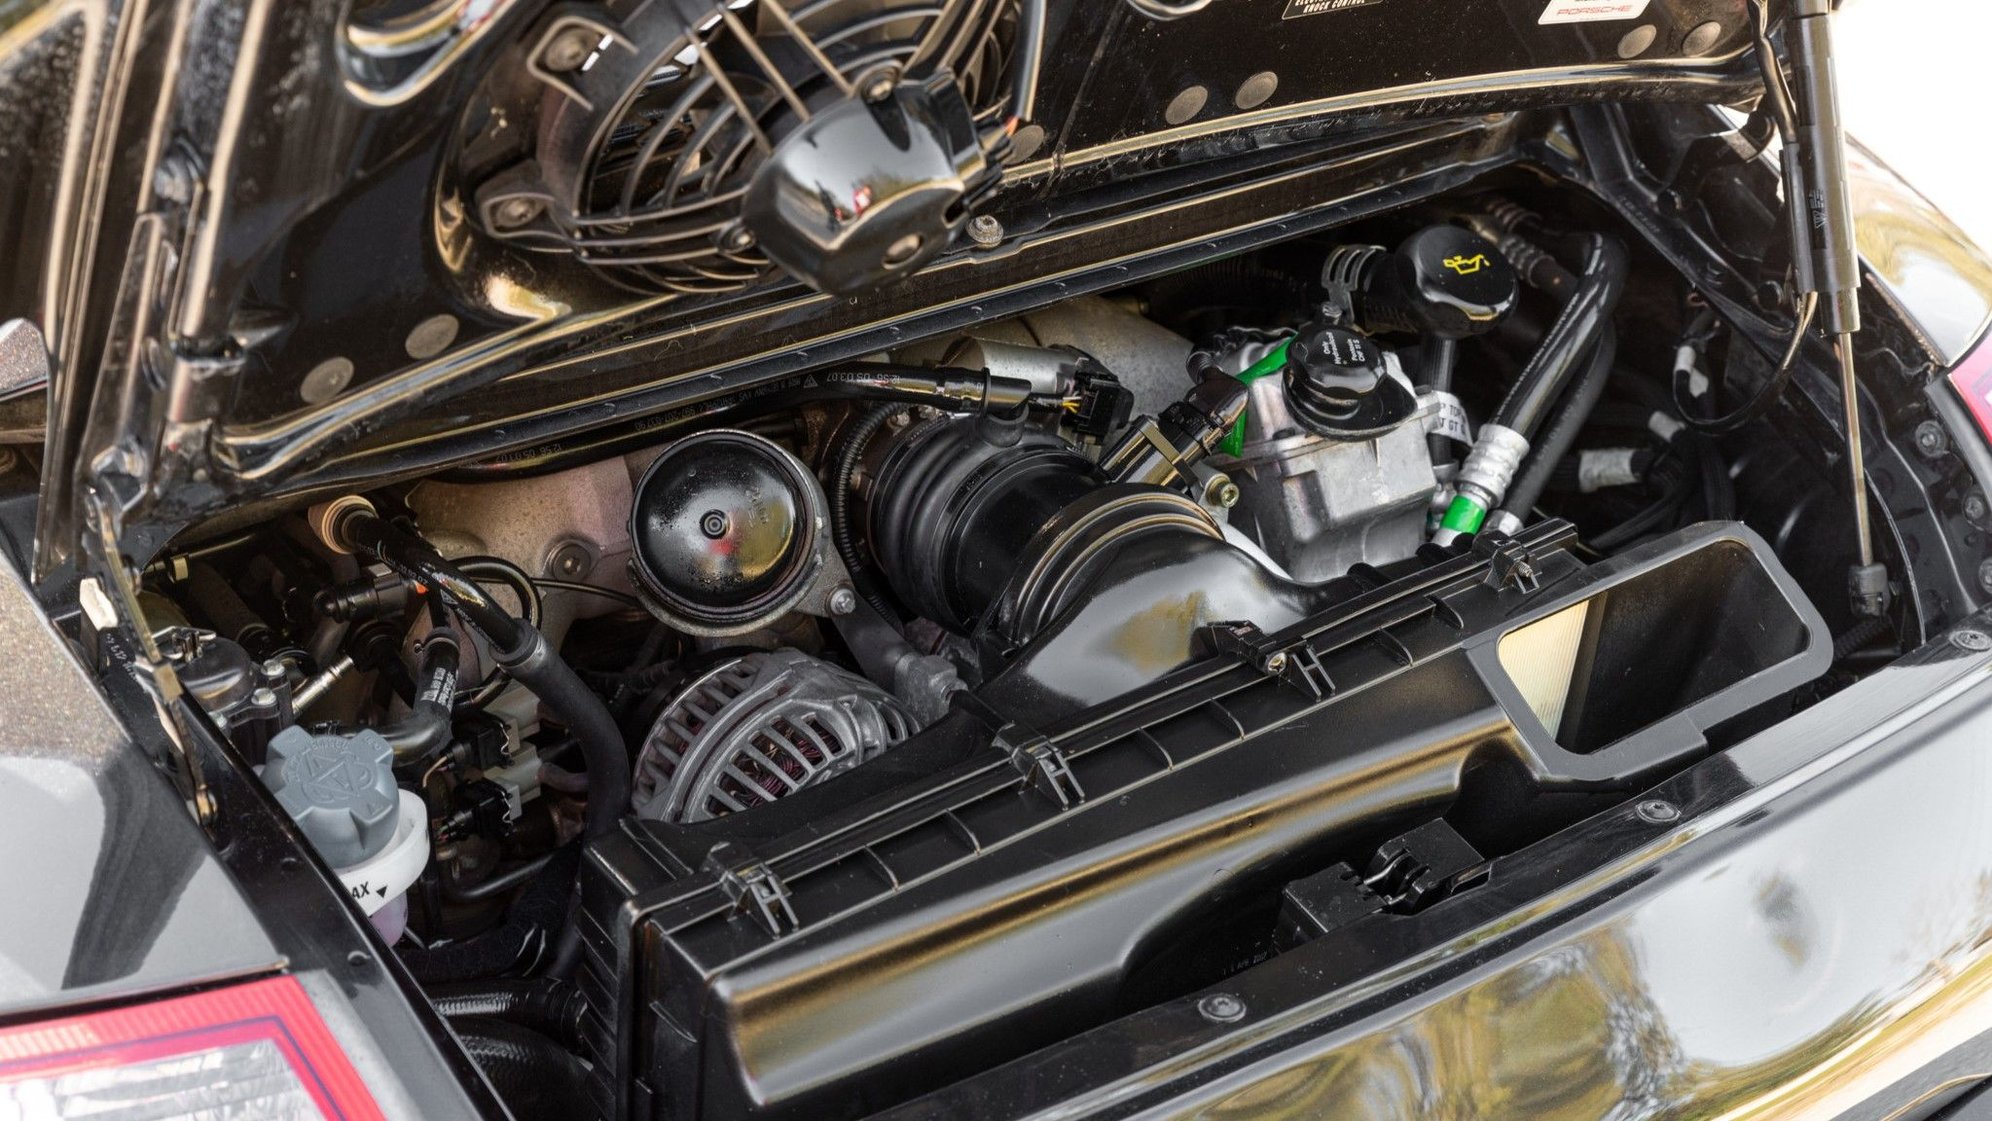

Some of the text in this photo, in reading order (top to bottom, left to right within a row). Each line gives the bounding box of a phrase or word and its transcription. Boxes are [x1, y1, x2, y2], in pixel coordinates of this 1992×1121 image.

[1303, 1, 1331, 13] KNOCK
[1557, 5, 1632, 15] PORSCHE
[351, 880, 371, 899] AX
